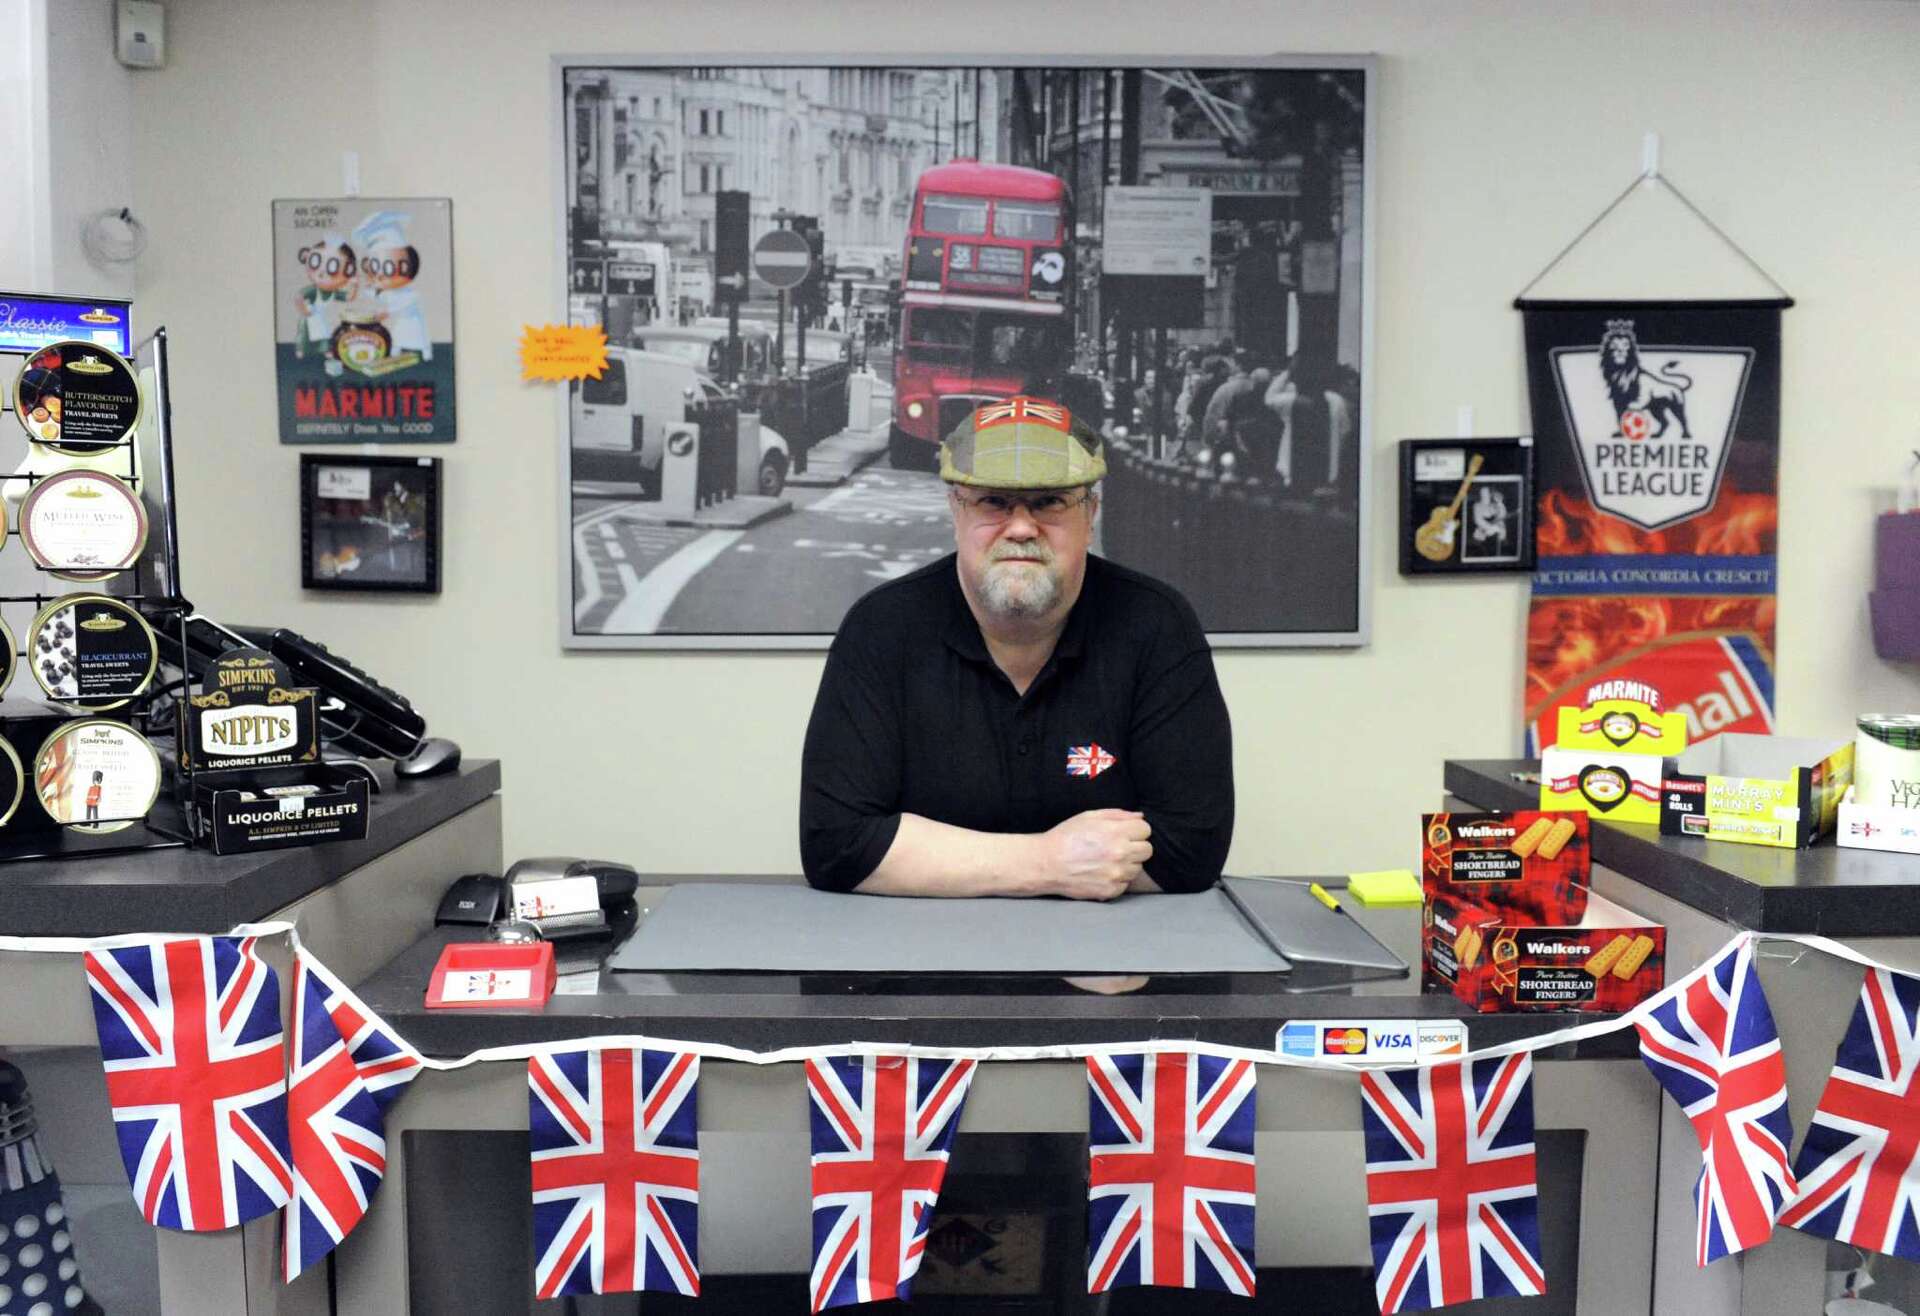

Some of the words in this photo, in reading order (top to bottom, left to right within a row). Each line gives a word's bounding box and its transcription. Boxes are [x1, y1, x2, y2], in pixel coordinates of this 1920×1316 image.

[64, 391, 132, 403] BUTTERSCOTCH
[295, 387, 434, 419] MARMITE
[64, 401, 118, 411] FLAVOURED
[64, 410, 92, 418] TRAVEL
[92, 412, 118, 420] SWEETS
[296, 423, 349, 434] DEFINITELY
[402, 422, 434, 434] GOOD
[1595, 443, 1709, 468] PREMIER
[1603, 471, 1704, 496] LEAGUE
[1612, 569, 1699, 584] CONCORDIA
[80, 652, 148, 662] BLACKCURRANT
[218, 669, 276, 687] SIMPKINS
[1587, 680, 1659, 707] MARMITE
[210, 715, 291, 746] NIPITS
[80, 738, 124, 746] SIMPKINS
[208, 758, 256, 768] LIQUORICE
[258, 755, 292, 765] PELLETS
[1669, 793, 1681, 803] 40
[1712, 784, 1784, 802] MURRAY
[1669, 802, 1693, 812] ROLLS
[1712, 800, 1764, 813] MINTS
[228, 811, 302, 825] LIQUORICE
[307, 803, 358, 818] PELLETS
[263, 825, 292, 834] SIMPKIN
[1458, 826, 1516, 839] Walkers
[1453, 860, 1521, 872] SHORTBREAD
[1468, 869, 1506, 879] FINGERS
[1527, 942, 1591, 955] Walkers
[1520, 980, 1593, 991] SHORTBREAD
[1535, 990, 1577, 1000] FINGERS
[1374, 1034, 1412, 1048] VISA
[1419, 1034, 1460, 1043] DISCOVER
